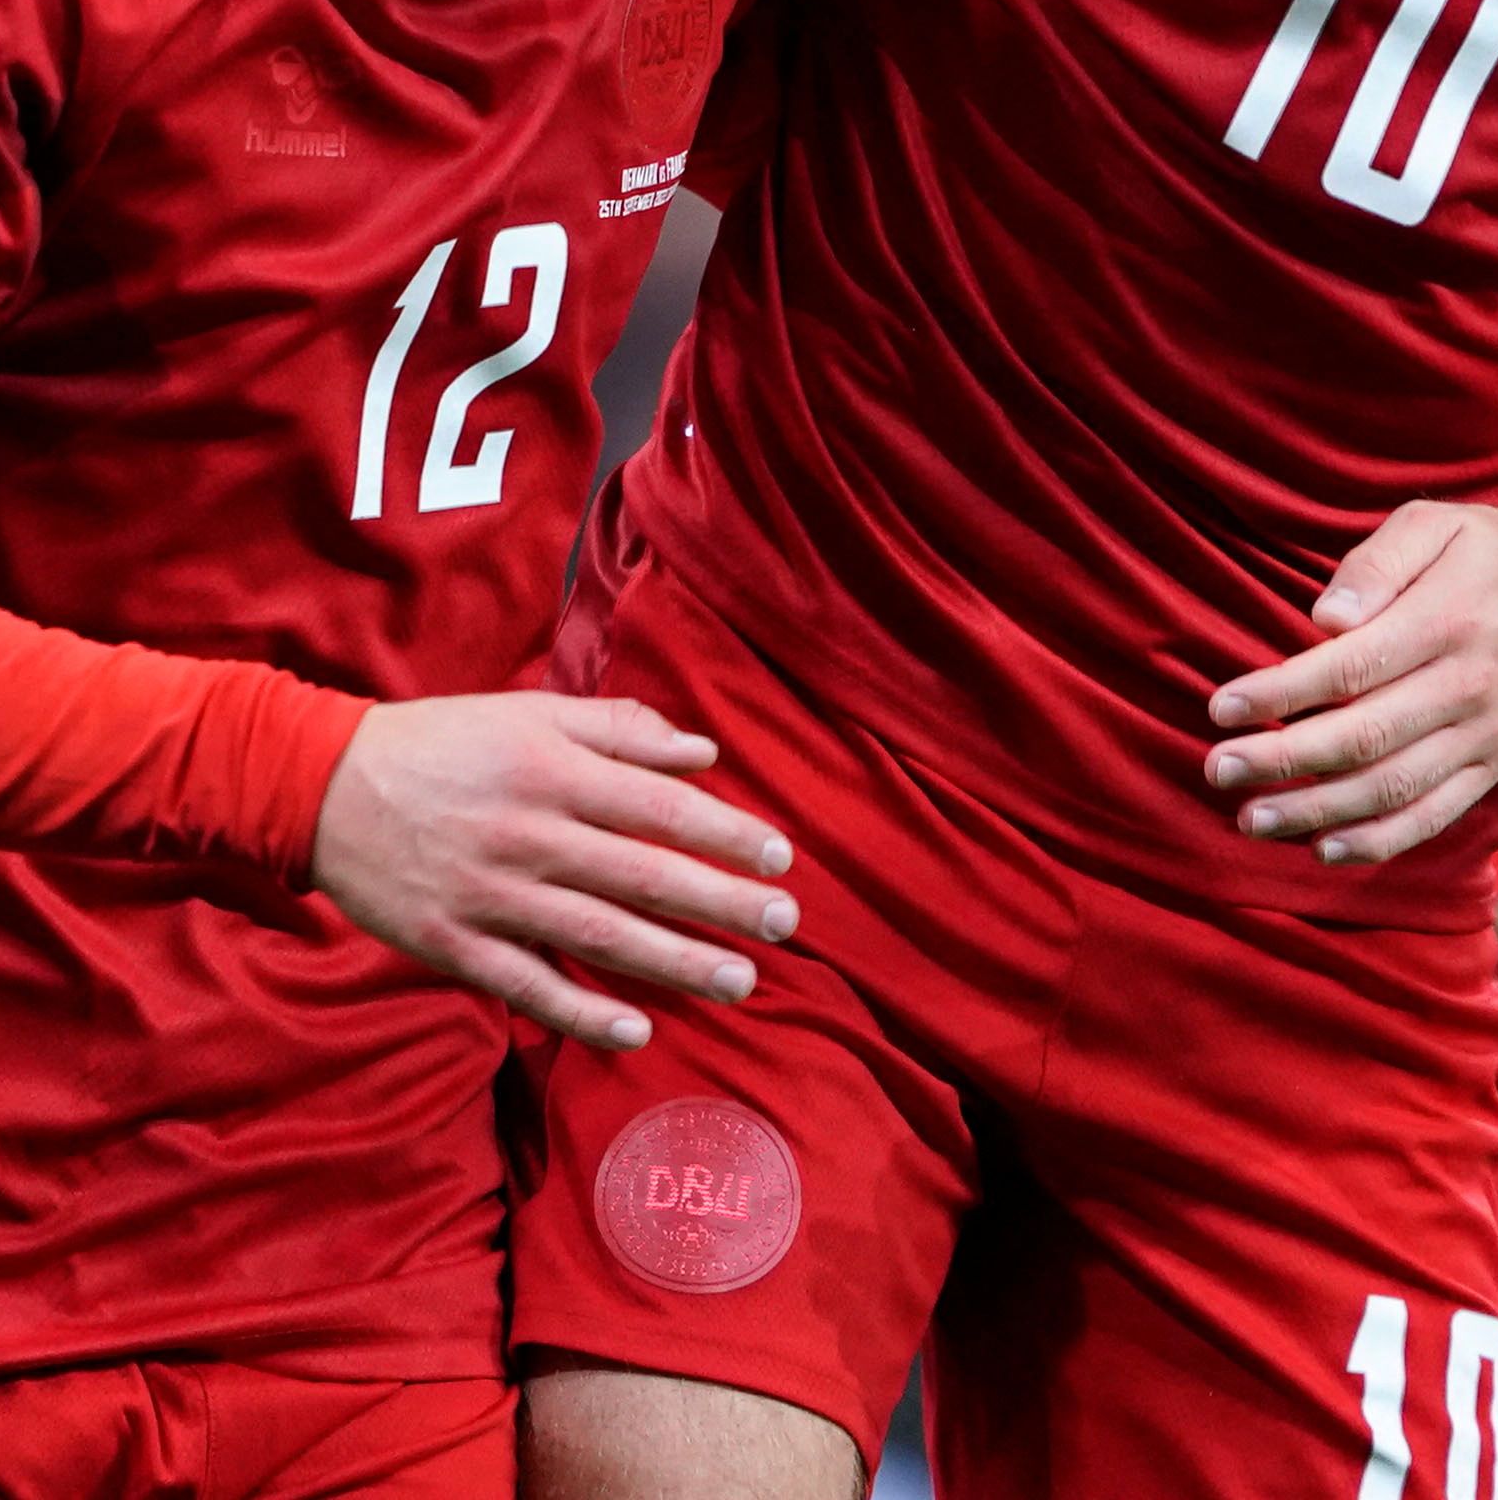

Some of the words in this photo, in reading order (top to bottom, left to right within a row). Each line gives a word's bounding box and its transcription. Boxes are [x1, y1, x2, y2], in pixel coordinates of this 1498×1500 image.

[244, 118, 347, 158] hummel
[350, 221, 568, 520] 12
[644, 1162, 756, 1222] DBU
